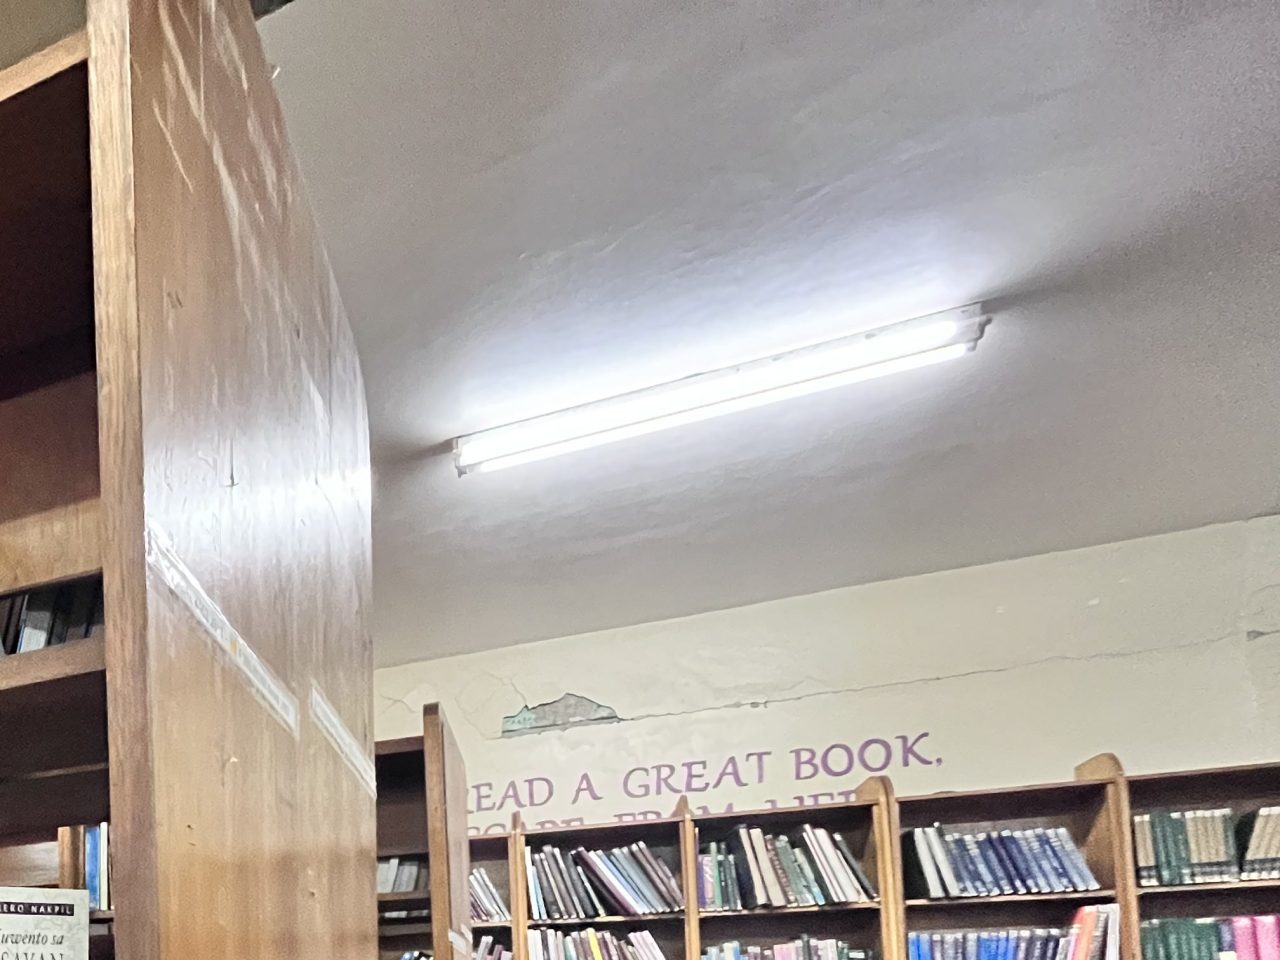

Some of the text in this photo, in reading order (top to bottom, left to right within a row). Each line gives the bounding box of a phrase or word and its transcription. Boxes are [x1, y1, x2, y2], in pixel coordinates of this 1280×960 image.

[467, 732, 943, 814] EAD A GREAT BOOK,
[31, 905, 72, 915] NAKPIL
[50, 934, 64, 945] sa
